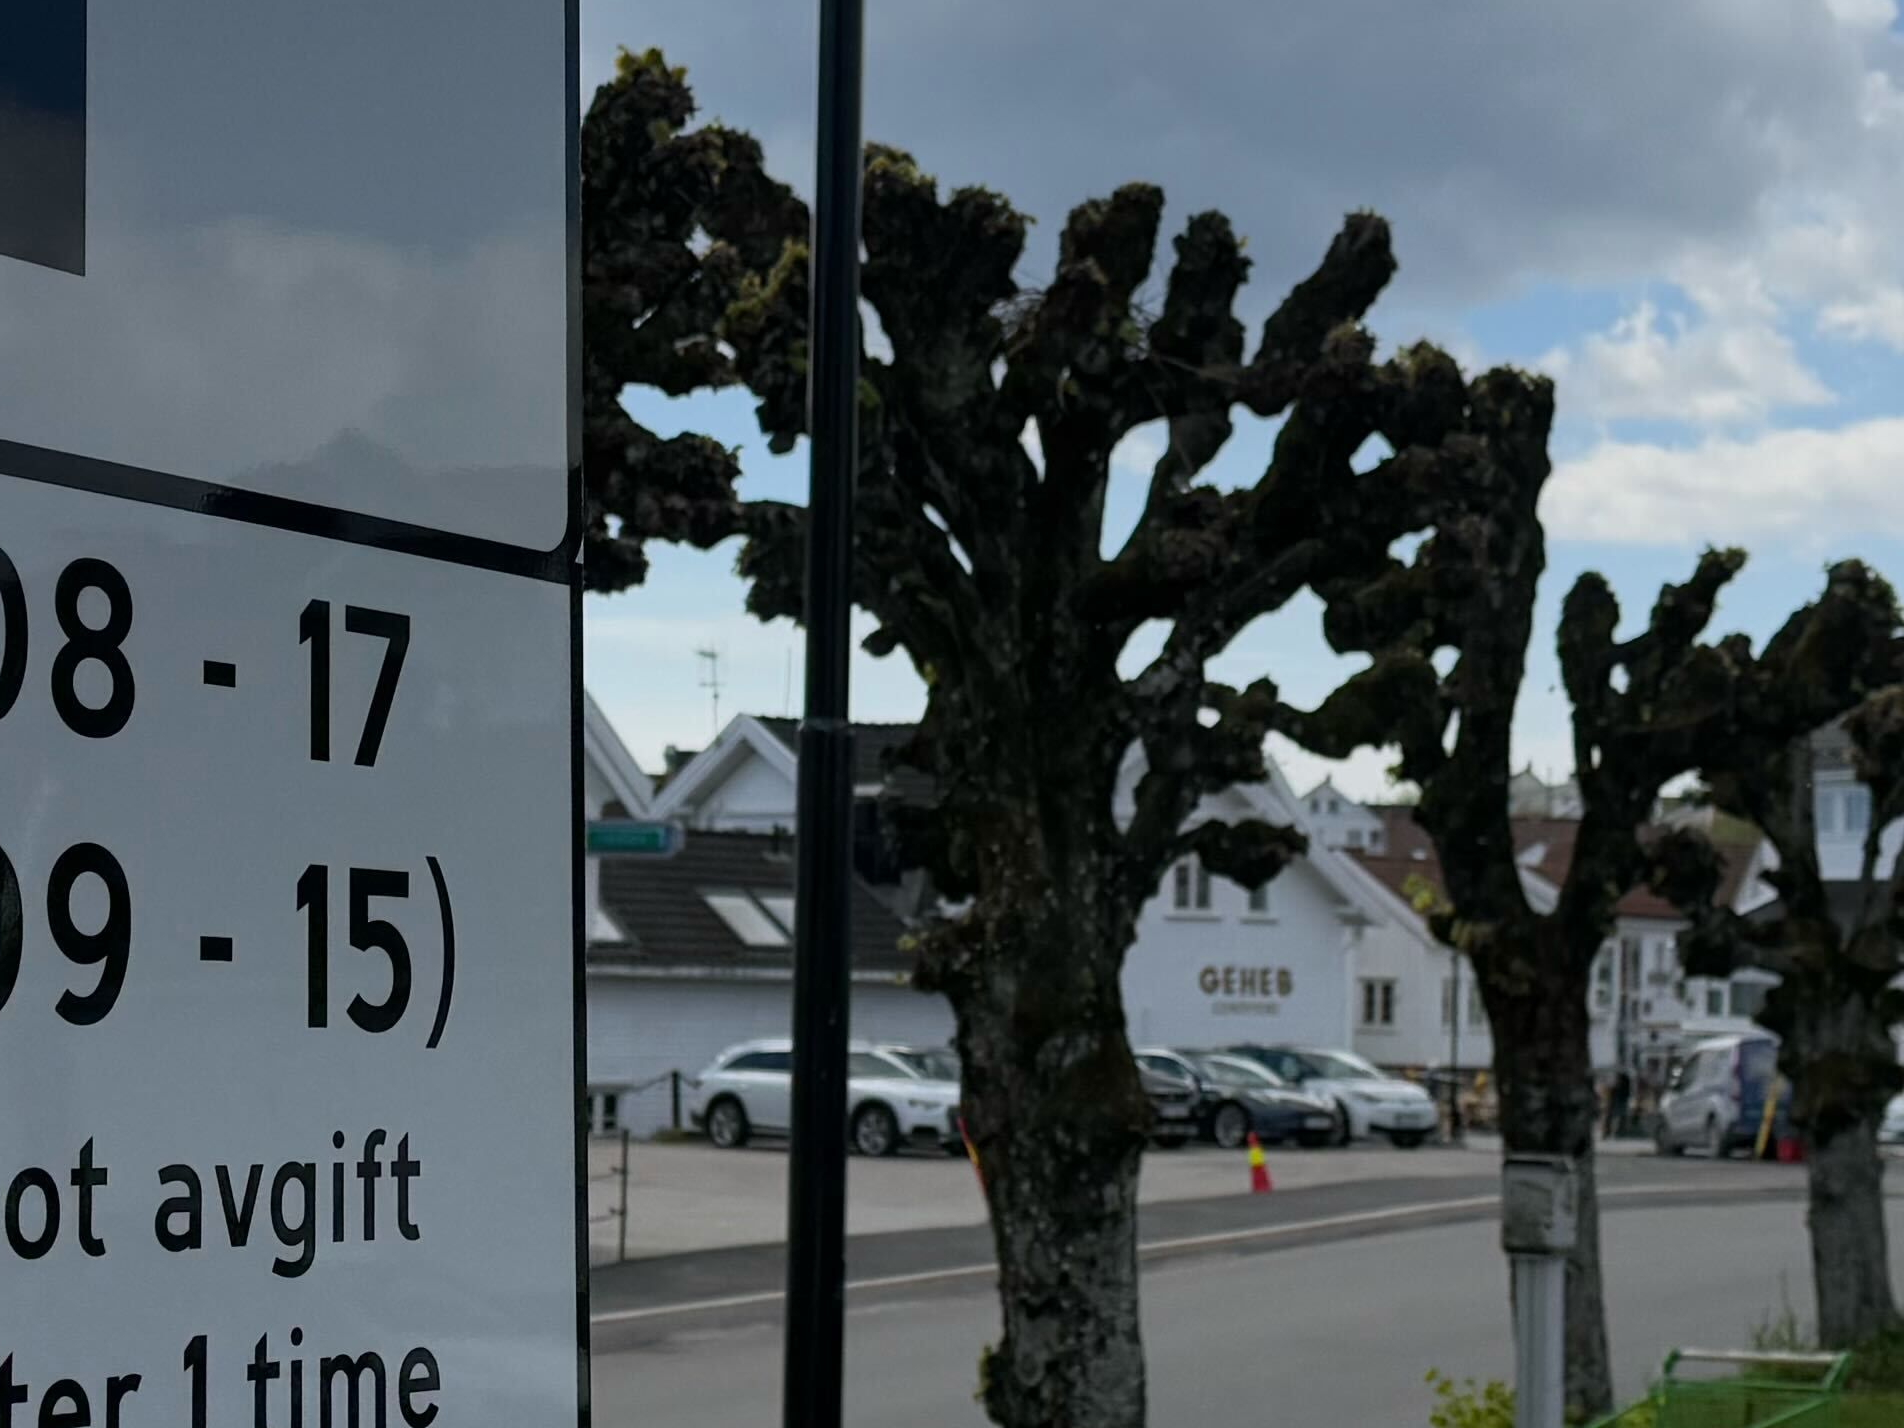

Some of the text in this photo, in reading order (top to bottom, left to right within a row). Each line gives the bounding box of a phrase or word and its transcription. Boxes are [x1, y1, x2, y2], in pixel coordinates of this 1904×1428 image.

[203, 659, 236, 688] -
[299, 598, 411, 768] 17
[199, 935, 233, 962] -
[296, 855, 455, 1049] 15)
[154, 1128, 421, 1278] avgift
